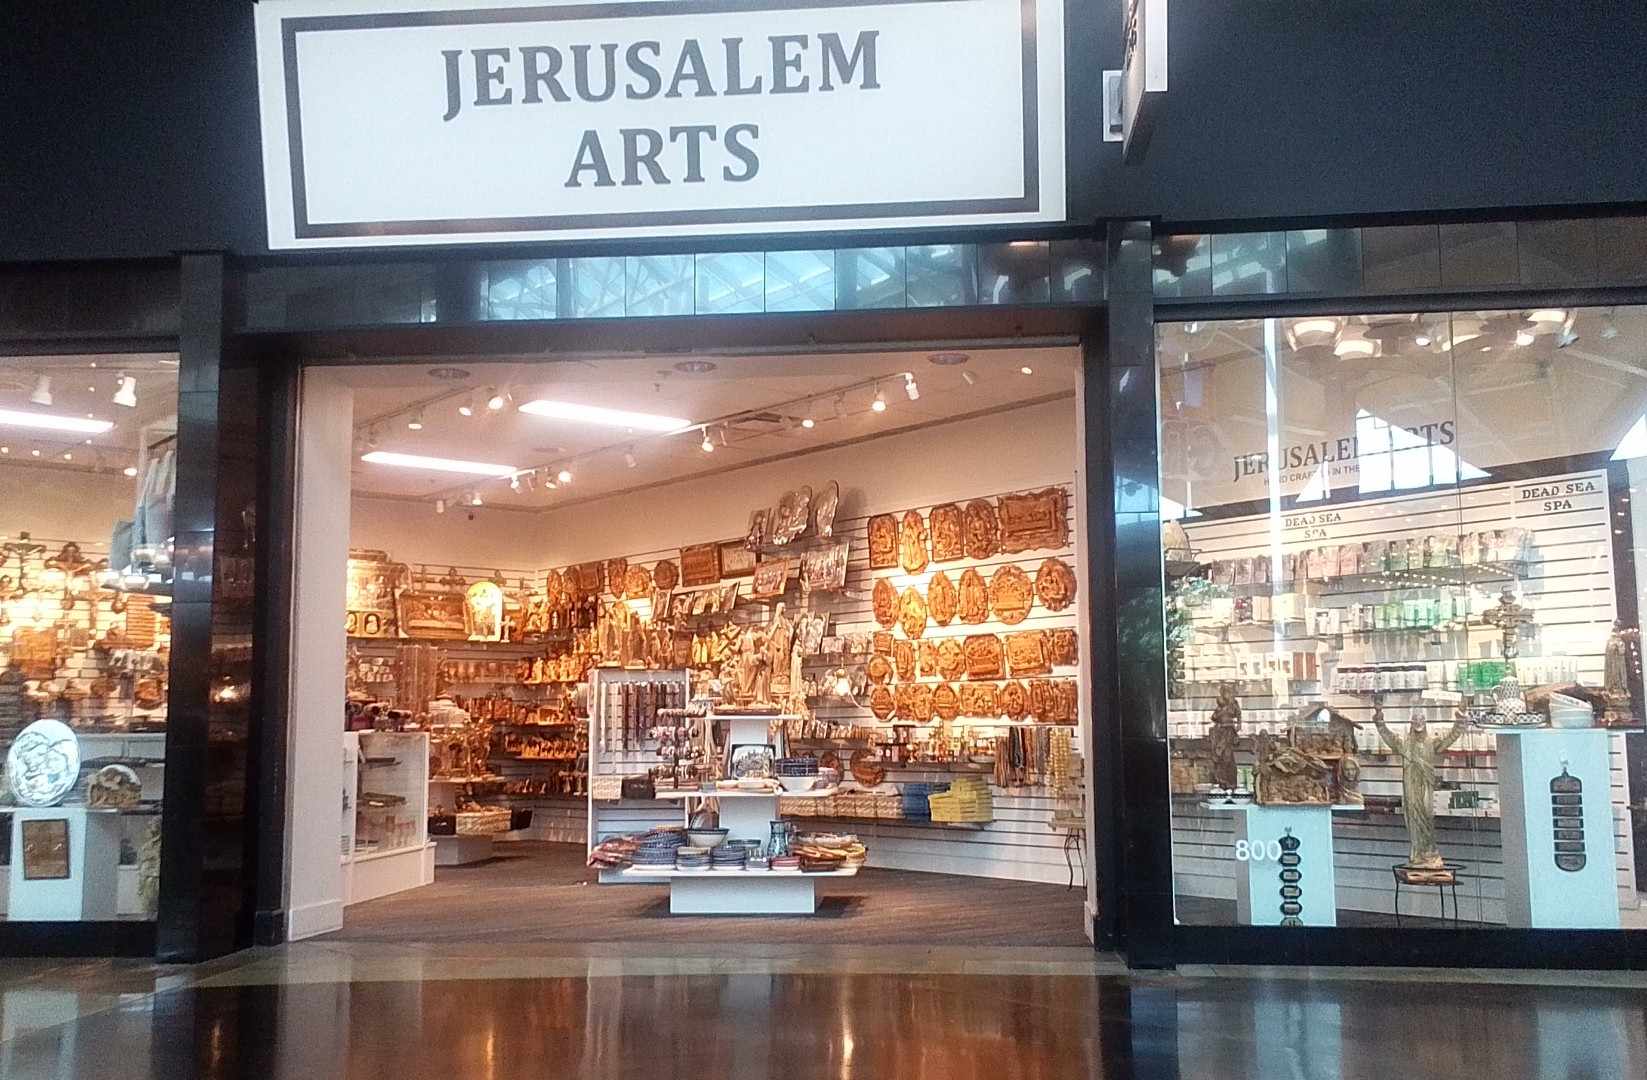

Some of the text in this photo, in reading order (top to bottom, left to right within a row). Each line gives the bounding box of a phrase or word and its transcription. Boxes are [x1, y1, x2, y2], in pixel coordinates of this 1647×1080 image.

[441, 30, 881, 122] JERUSALEM
[564, 123, 760, 188] ARTS
[1233, 436, 1364, 482] JERUSALE
[1522, 481, 1595, 499] DEAD SEA
[1543, 500, 1572, 511] SPA
[1318, 513, 1342, 523] SEA
[1235, 839, 1282, 861] 800
